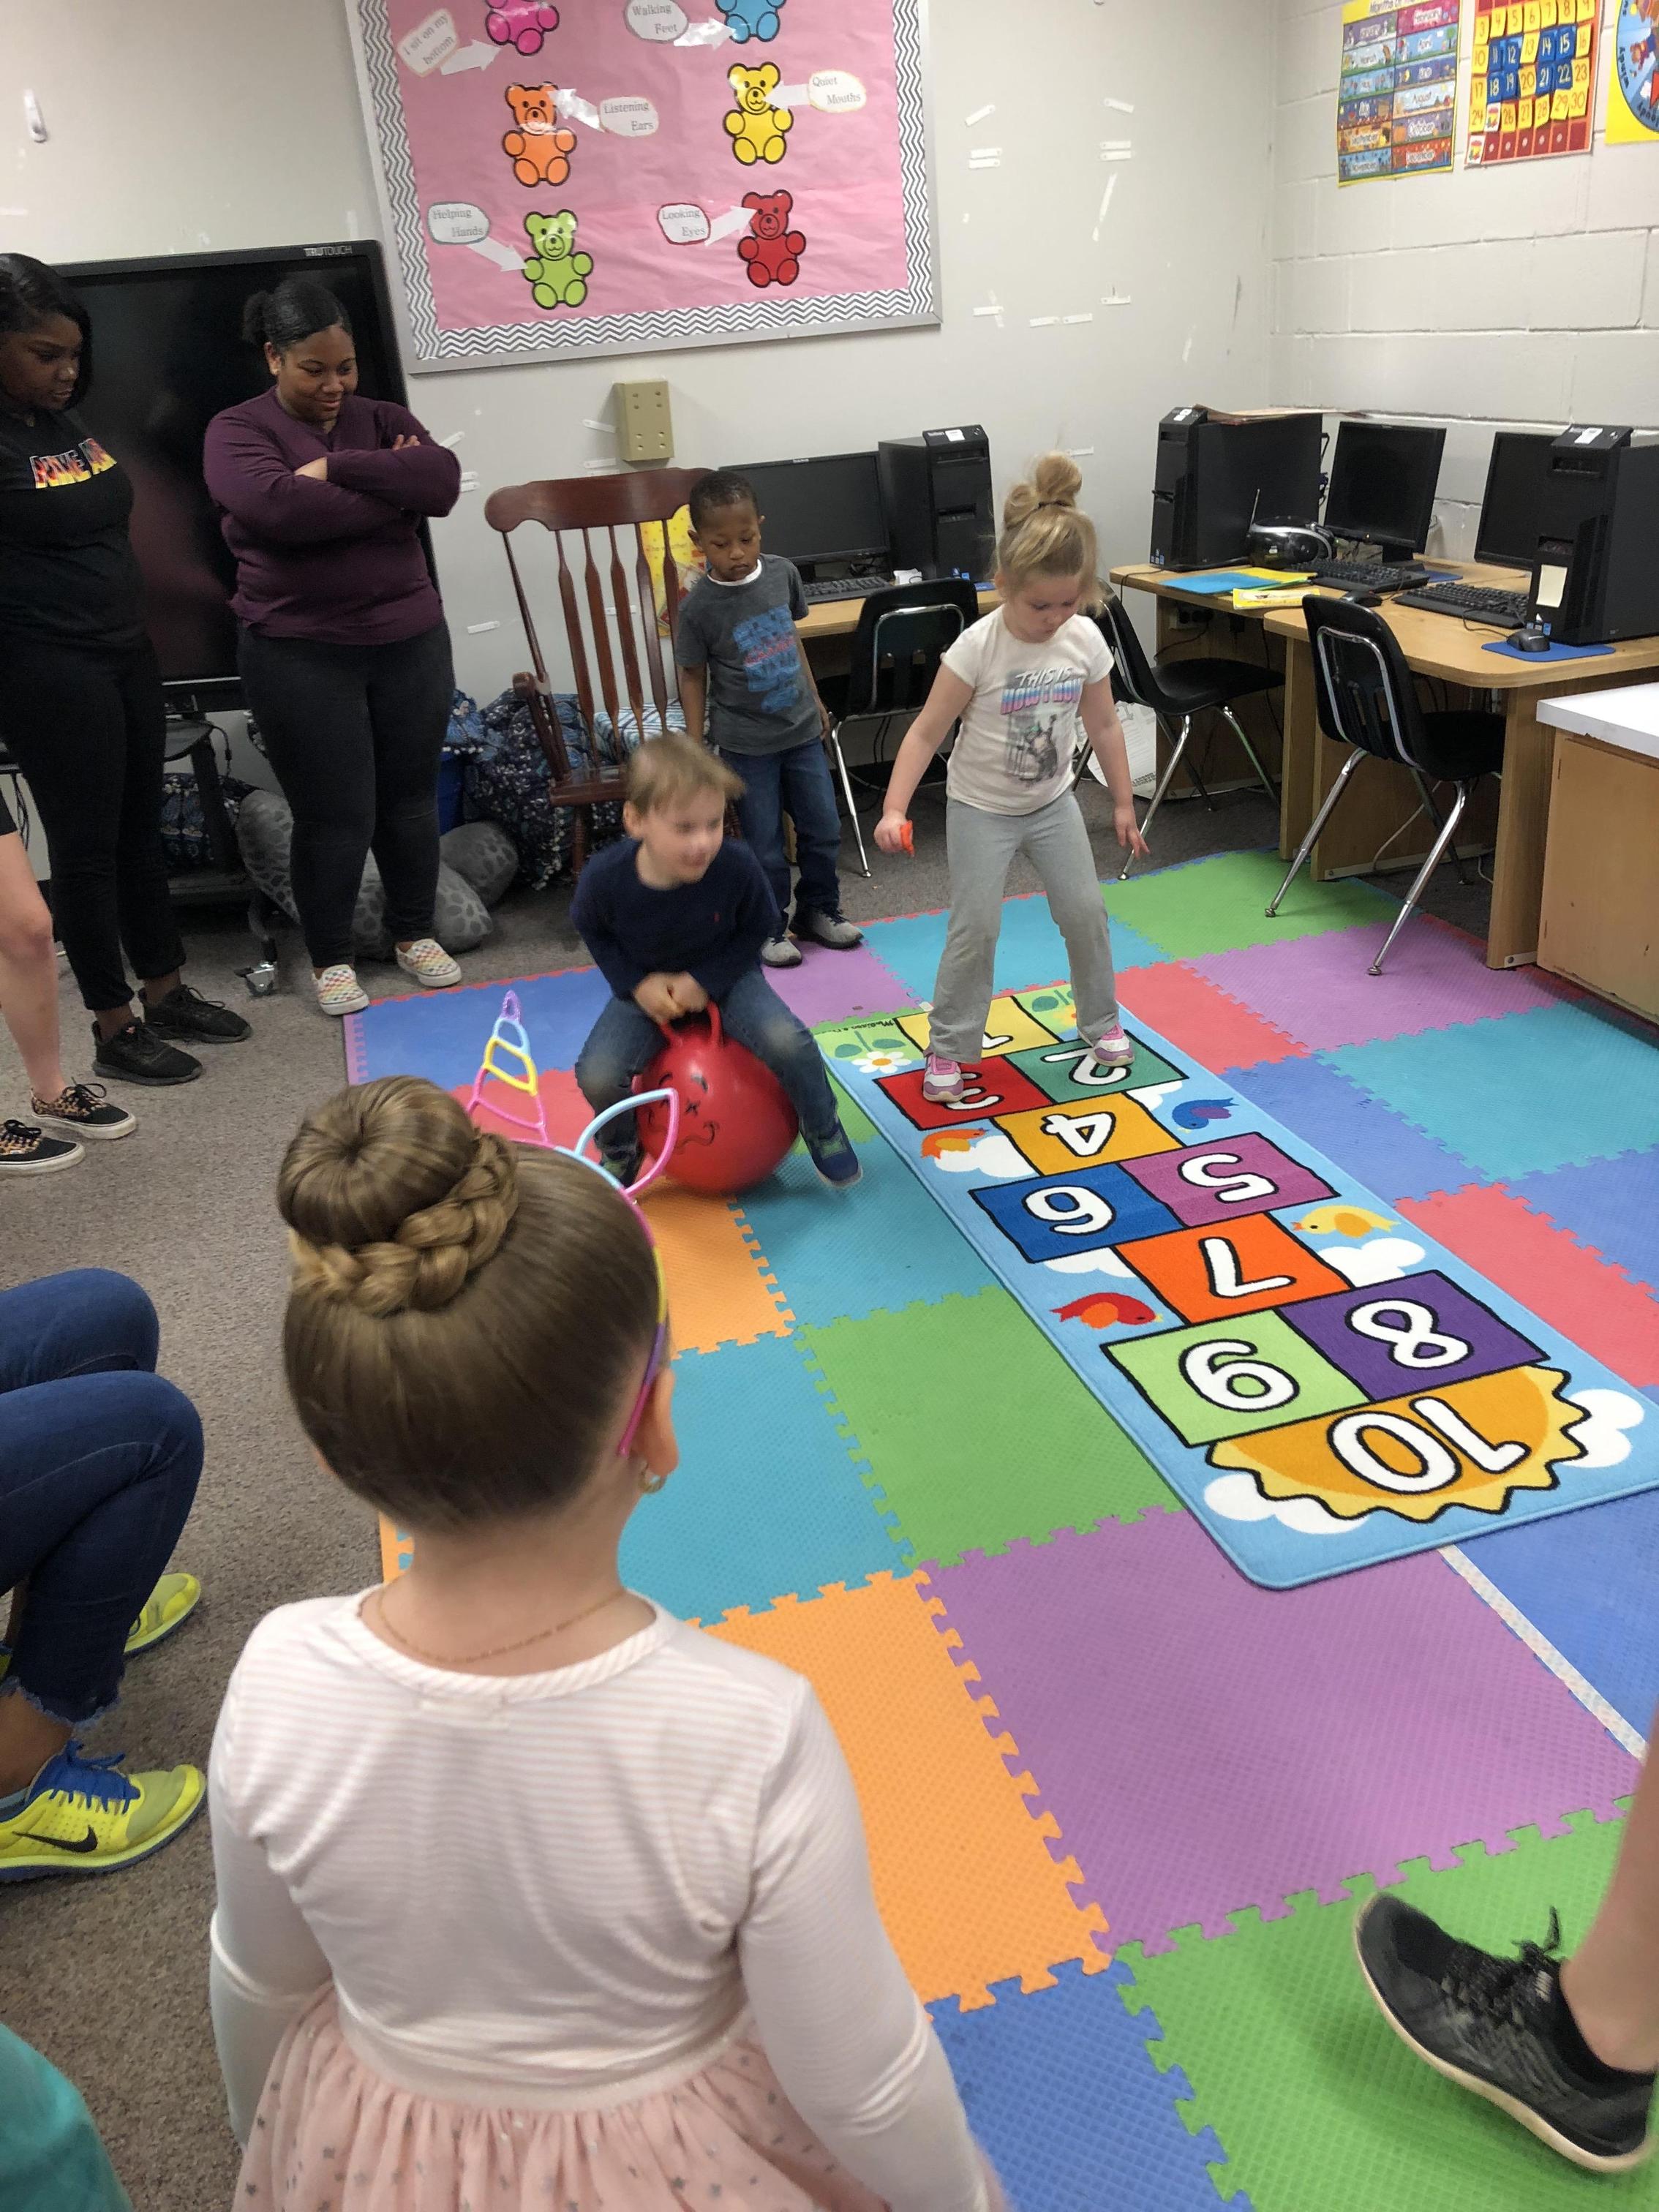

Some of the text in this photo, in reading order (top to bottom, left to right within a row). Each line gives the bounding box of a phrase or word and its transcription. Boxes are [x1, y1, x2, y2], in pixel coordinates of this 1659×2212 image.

[632, 4, 672, 15] Walking
[1511, 10, 1519, 26] 5
[1529, 7, 1536, 21] 6
[1545, 1, 1551, 18] 7
[1563, 0, 1571, 17] 8
[423, 26, 435, 39] on
[655, 23, 677, 34] Feet
[423, 36, 455, 64] bottom
[1474, 33, 1588, 67] 10 11 12 13 14 15 16
[812, 76, 838, 88] Quiet
[1475, 64, 1587, 99] 17 18 19 20 21 22 23
[603, 102, 650, 113] Listening
[827, 92, 862, 105] Mouths
[1472, 91, 1586, 126] 24 26 27 28 29 30
[631, 120, 654, 131] Ears
[433, 208, 473, 219] Helping
[661, 208, 701, 220] Looking
[451, 225, 484, 237] Hands
[682, 226, 705, 237] Eyes
[29, 449, 92, 489] HAVE
[1015, 666, 1073, 688] THIS IS
[1000, 685, 1041, 715] HOW
[1042, 685, 1050, 703] I
[1041, 1046, 1131, 1087] 2
[1042, 1110, 1116, 1157] 4
[1178, 1151, 1282, 1206] 5
[1022, 1182, 1119, 1236] 6
[1197, 1235, 1298, 1300] 7
[1344, 1296, 1475, 1371] 8
[1176, 1337, 1302, 1413] 9
[1325, 1394, 1532, 1496] 10
